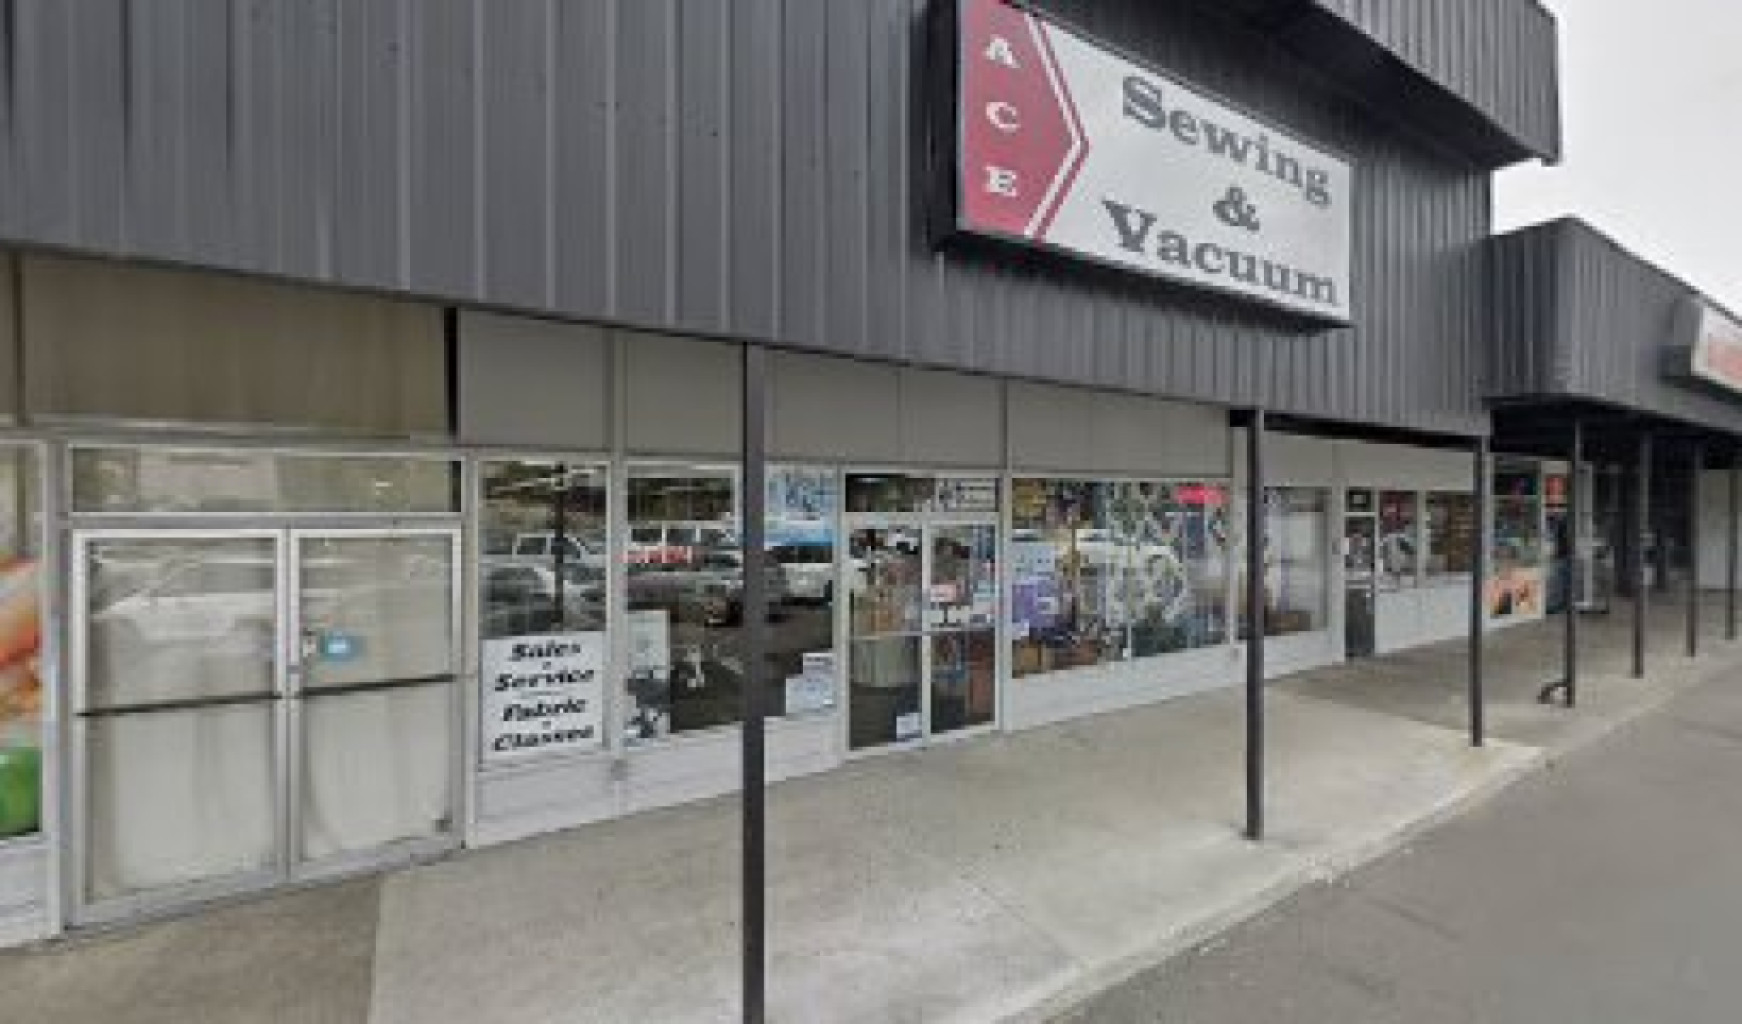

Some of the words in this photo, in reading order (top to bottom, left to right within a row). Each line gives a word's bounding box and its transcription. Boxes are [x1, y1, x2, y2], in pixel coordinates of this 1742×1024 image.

[985, 35, 1021, 198] ACE
[1122, 75, 1332, 209] Sewing
[1212, 186, 1260, 231] &
[1101, 199, 1337, 306] Vacuum
[510, 641, 581, 662] Sales
[494, 667, 595, 692] Service
[503, 698, 587, 722] Fabric
[494, 725, 595, 751] Classes
